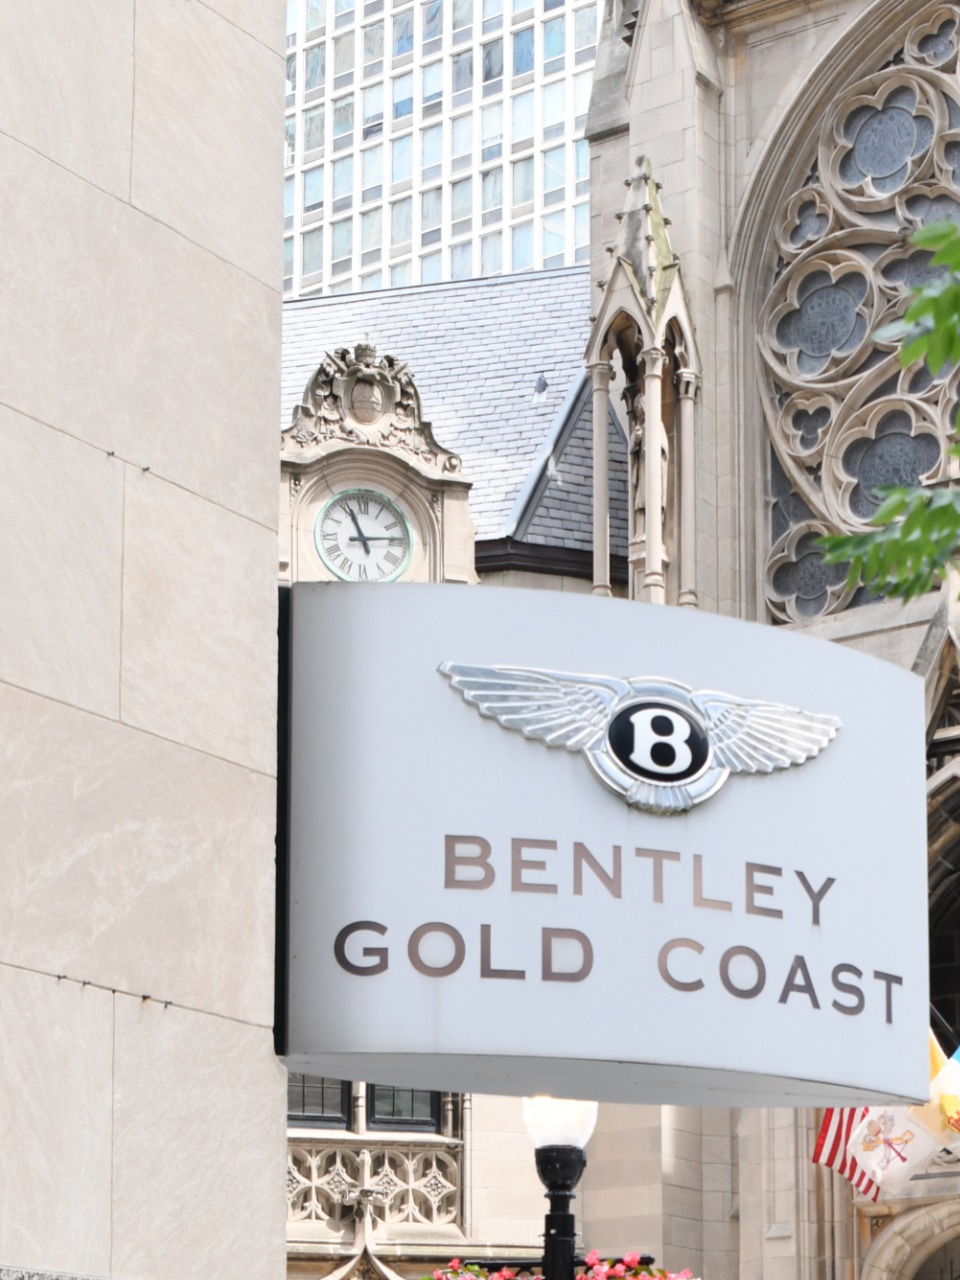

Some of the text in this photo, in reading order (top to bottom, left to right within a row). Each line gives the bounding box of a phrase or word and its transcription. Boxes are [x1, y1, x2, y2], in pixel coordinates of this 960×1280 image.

[628, 707, 693, 775] B
[443, 834, 837, 926] BENTLEY
[333, 920, 903, 1024] GOLD COAST
